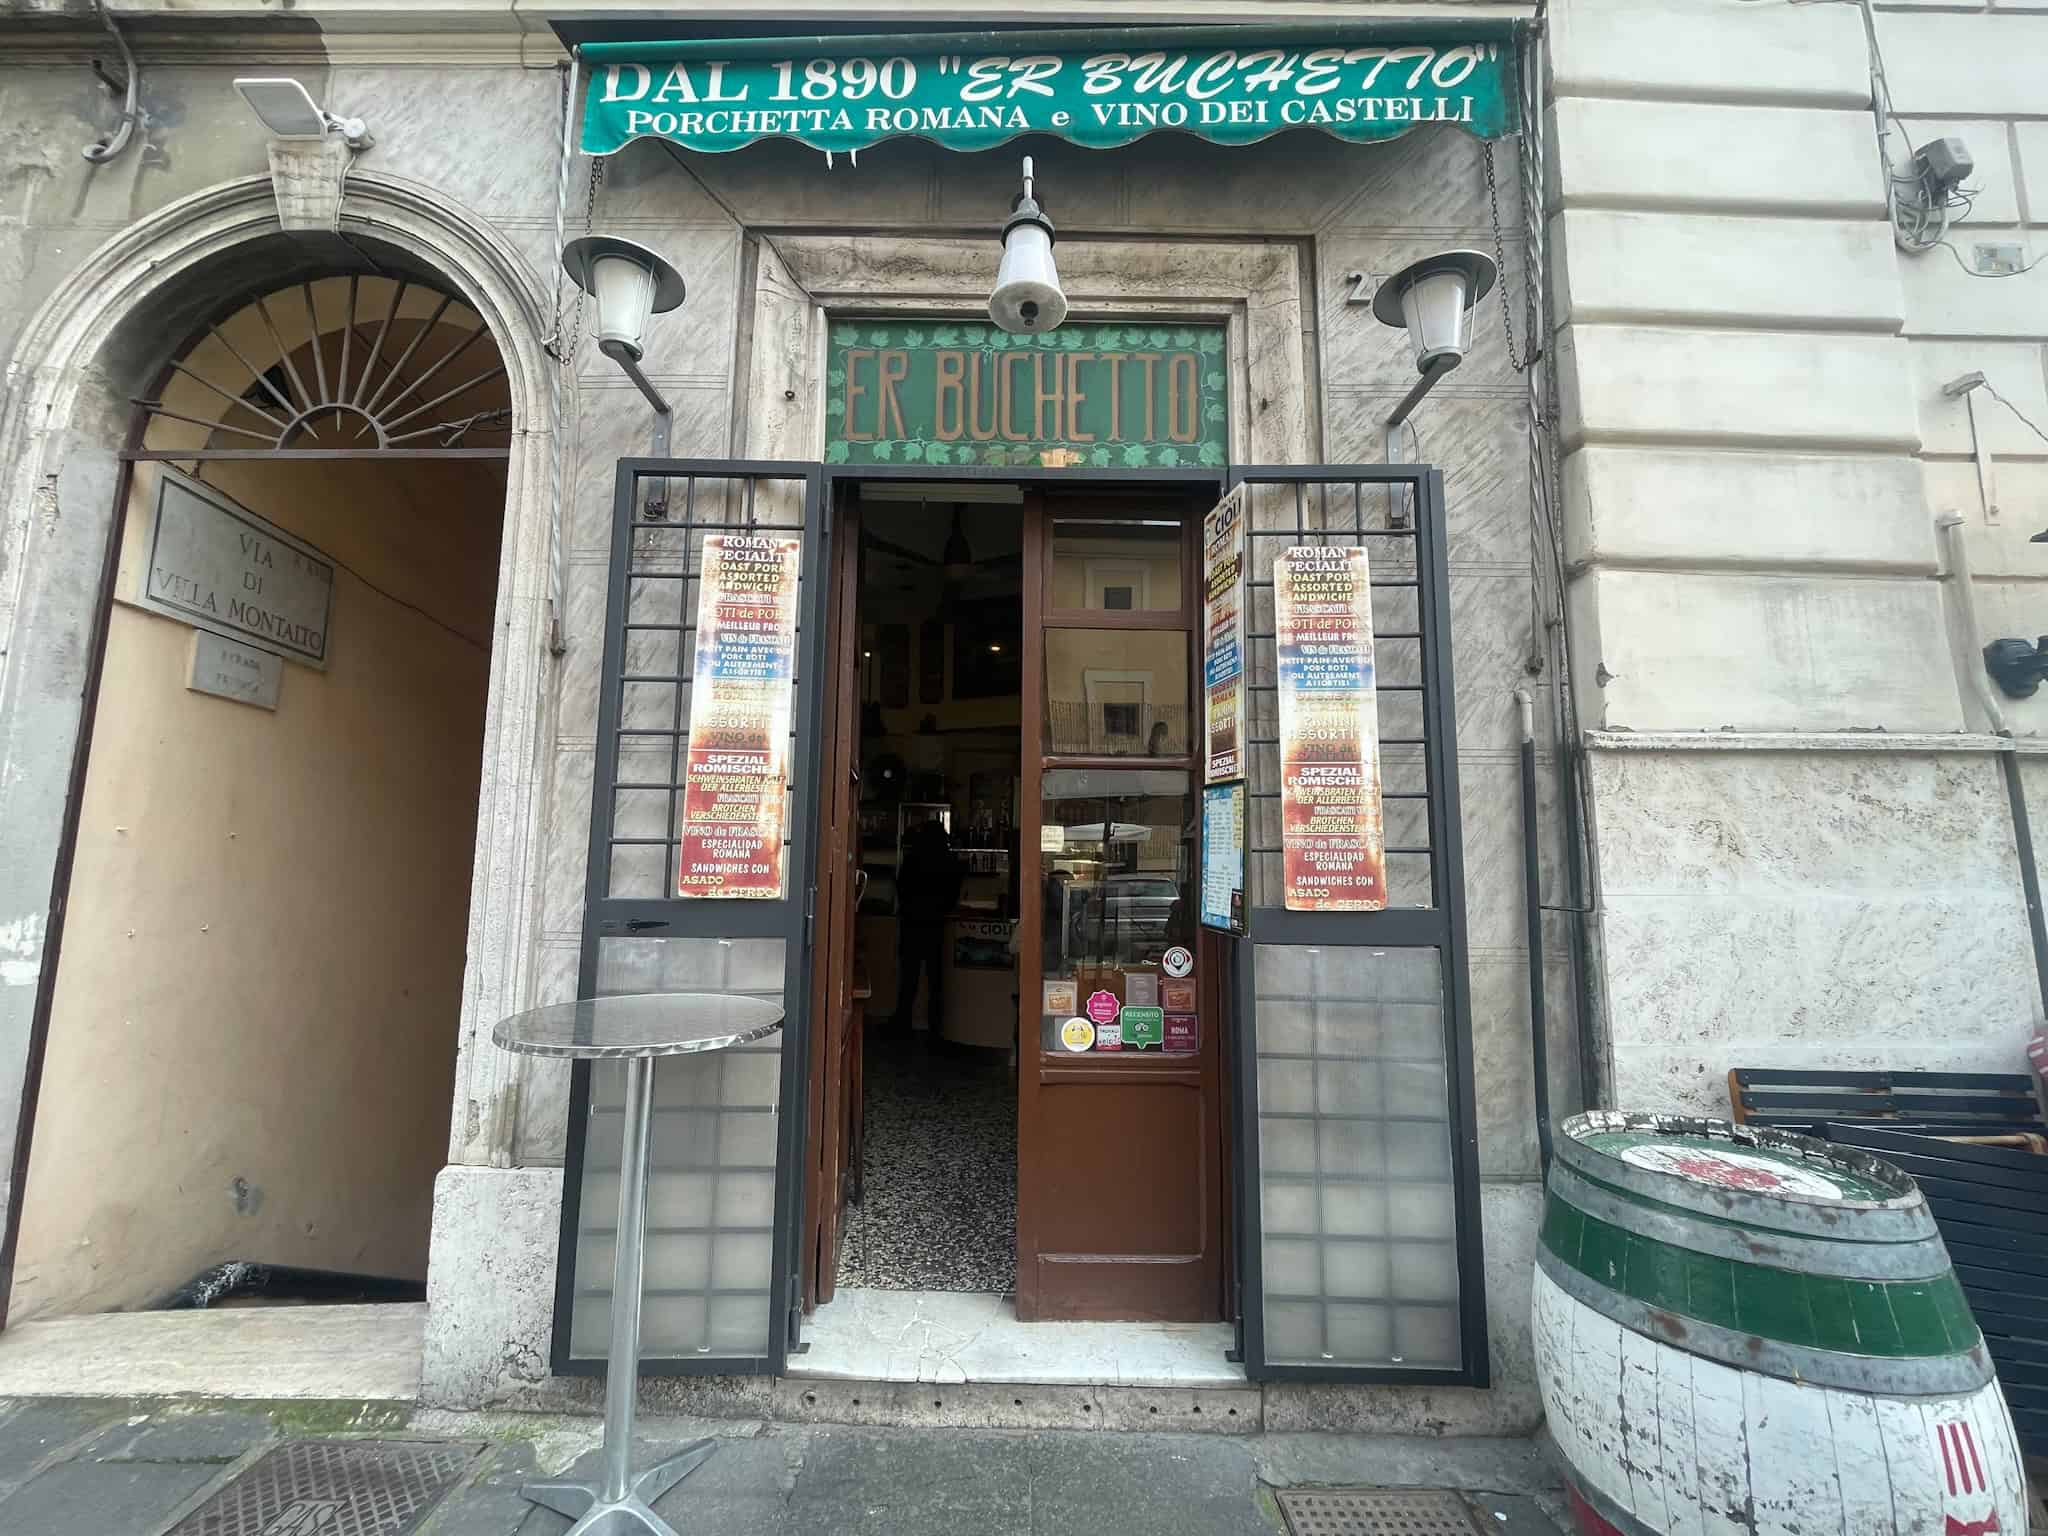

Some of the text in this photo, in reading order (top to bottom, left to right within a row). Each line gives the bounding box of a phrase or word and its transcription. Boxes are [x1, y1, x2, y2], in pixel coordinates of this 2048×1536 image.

[600, 60, 749, 104] DAL
[768, 56, 917, 101] 1890
[625, 95, 1475, 135] PORCHETTA ROMANA e VINO DEI CASTELLI
[845, 350, 1200, 443] ER BUCHETTO
[239, 532, 274, 570] VIA
[719, 572, 780, 583] ASSORTED
[243, 571, 263, 595] DI
[1292, 583, 1353, 592] ASSORTED
[228, 598, 323, 650] MONTALTO
[707, 755, 769, 765] SPEZIAL
[1301, 767, 1361, 777] SPEZIAL
[701, 840, 763, 850] ESPECIALIDAD
[713, 849, 751, 859] ROMANA
[1304, 851, 1365, 862] ESPECIALIDAD
[690, 863, 770, 874] SANDWICHES CON
[1315, 861, 1354, 871] ROMANA
[681, 875, 724, 885] ASADO
[1296, 876, 1375, 886] SANDWICHES CON
[1288, 888, 1331, 898] ASADO
